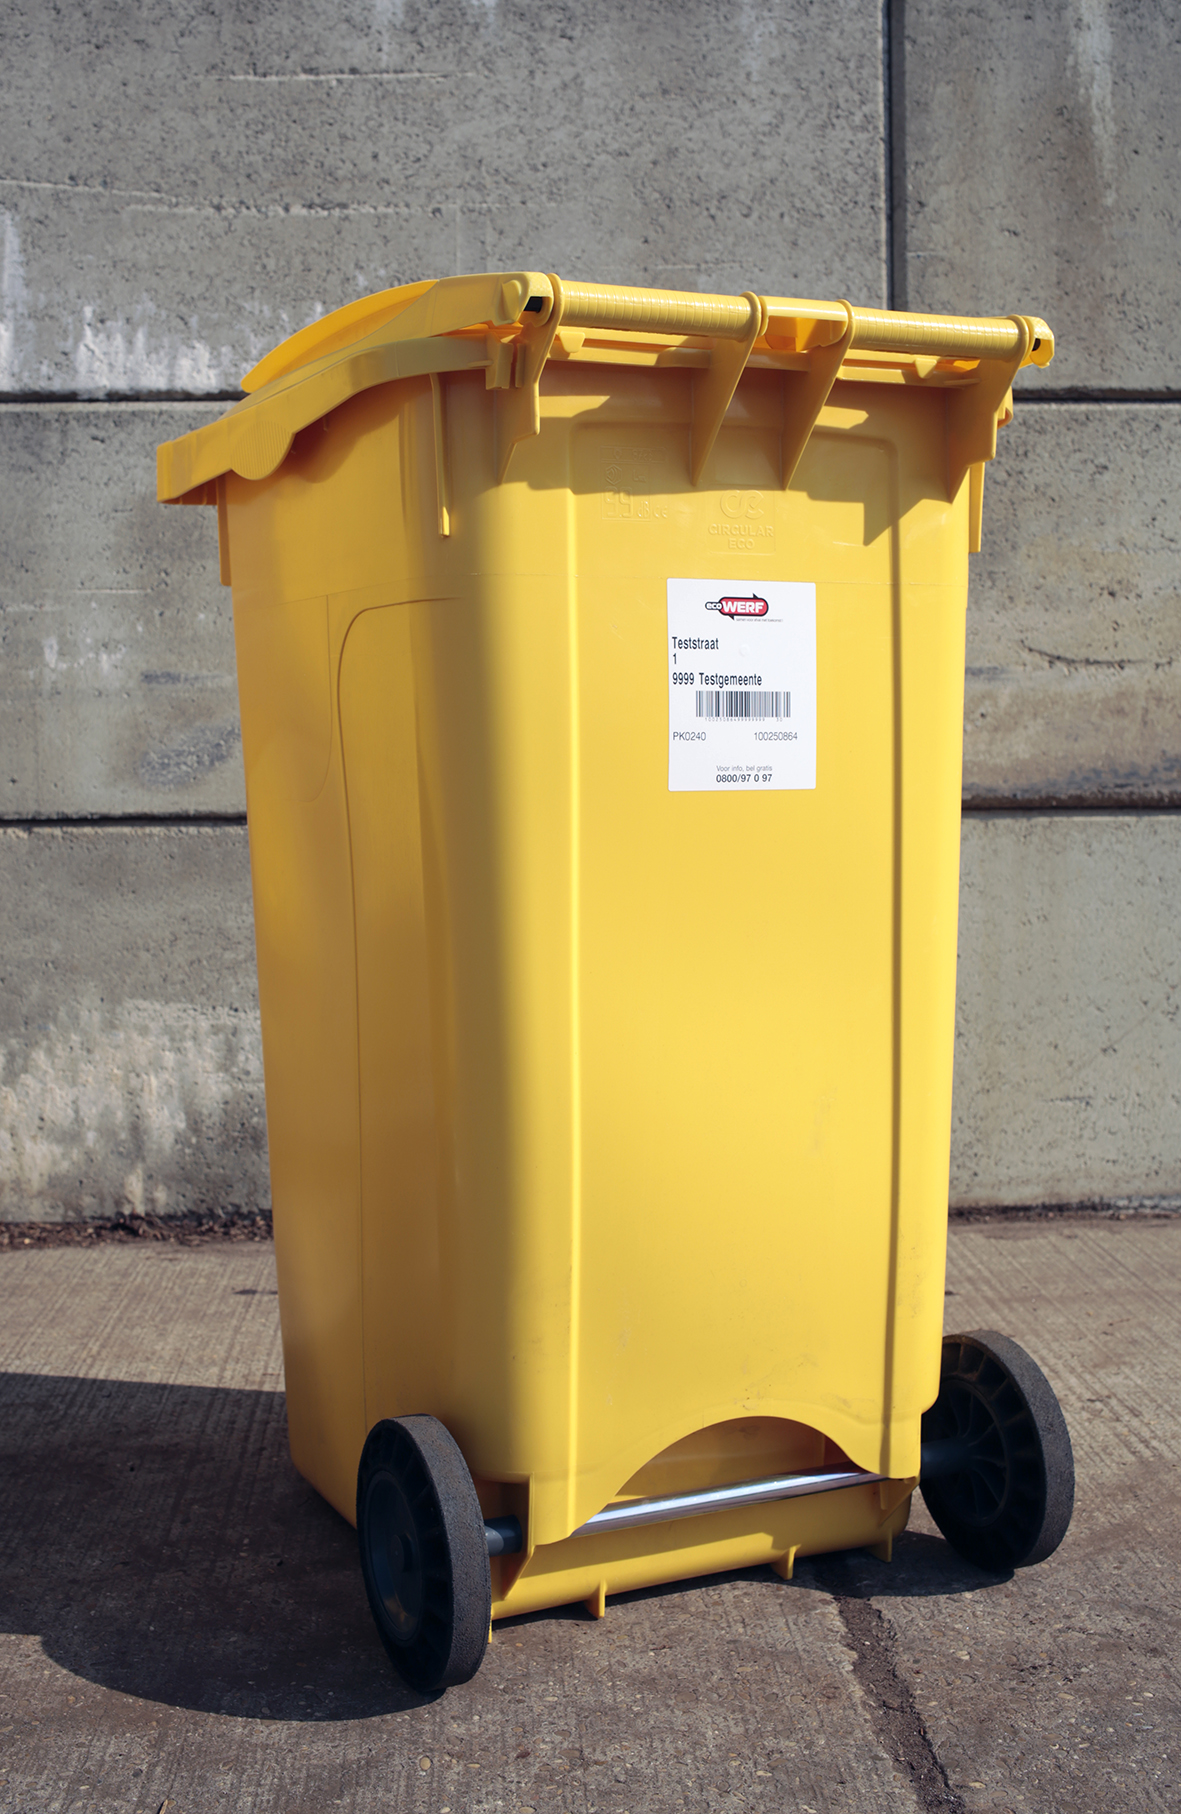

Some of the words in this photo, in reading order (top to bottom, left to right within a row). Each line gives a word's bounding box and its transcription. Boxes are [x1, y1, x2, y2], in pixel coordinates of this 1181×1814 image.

[708, 523, 775, 537] CIRCULAR
[728, 537, 756, 550] ECO
[671, 636, 719, 650] Teststraat
[672, 653, 677, 664] 1
[672, 671, 695, 685] 9999
[698, 672, 763, 689] Testgemeente
[672, 731, 707, 742] PK0240
[754, 731, 798, 742] 100250864
[756, 765, 773, 773] gratis
[716, 774, 751, 783] 0800/97
[753, 774, 760, 783] 0
[762, 774, 772, 783] 97
